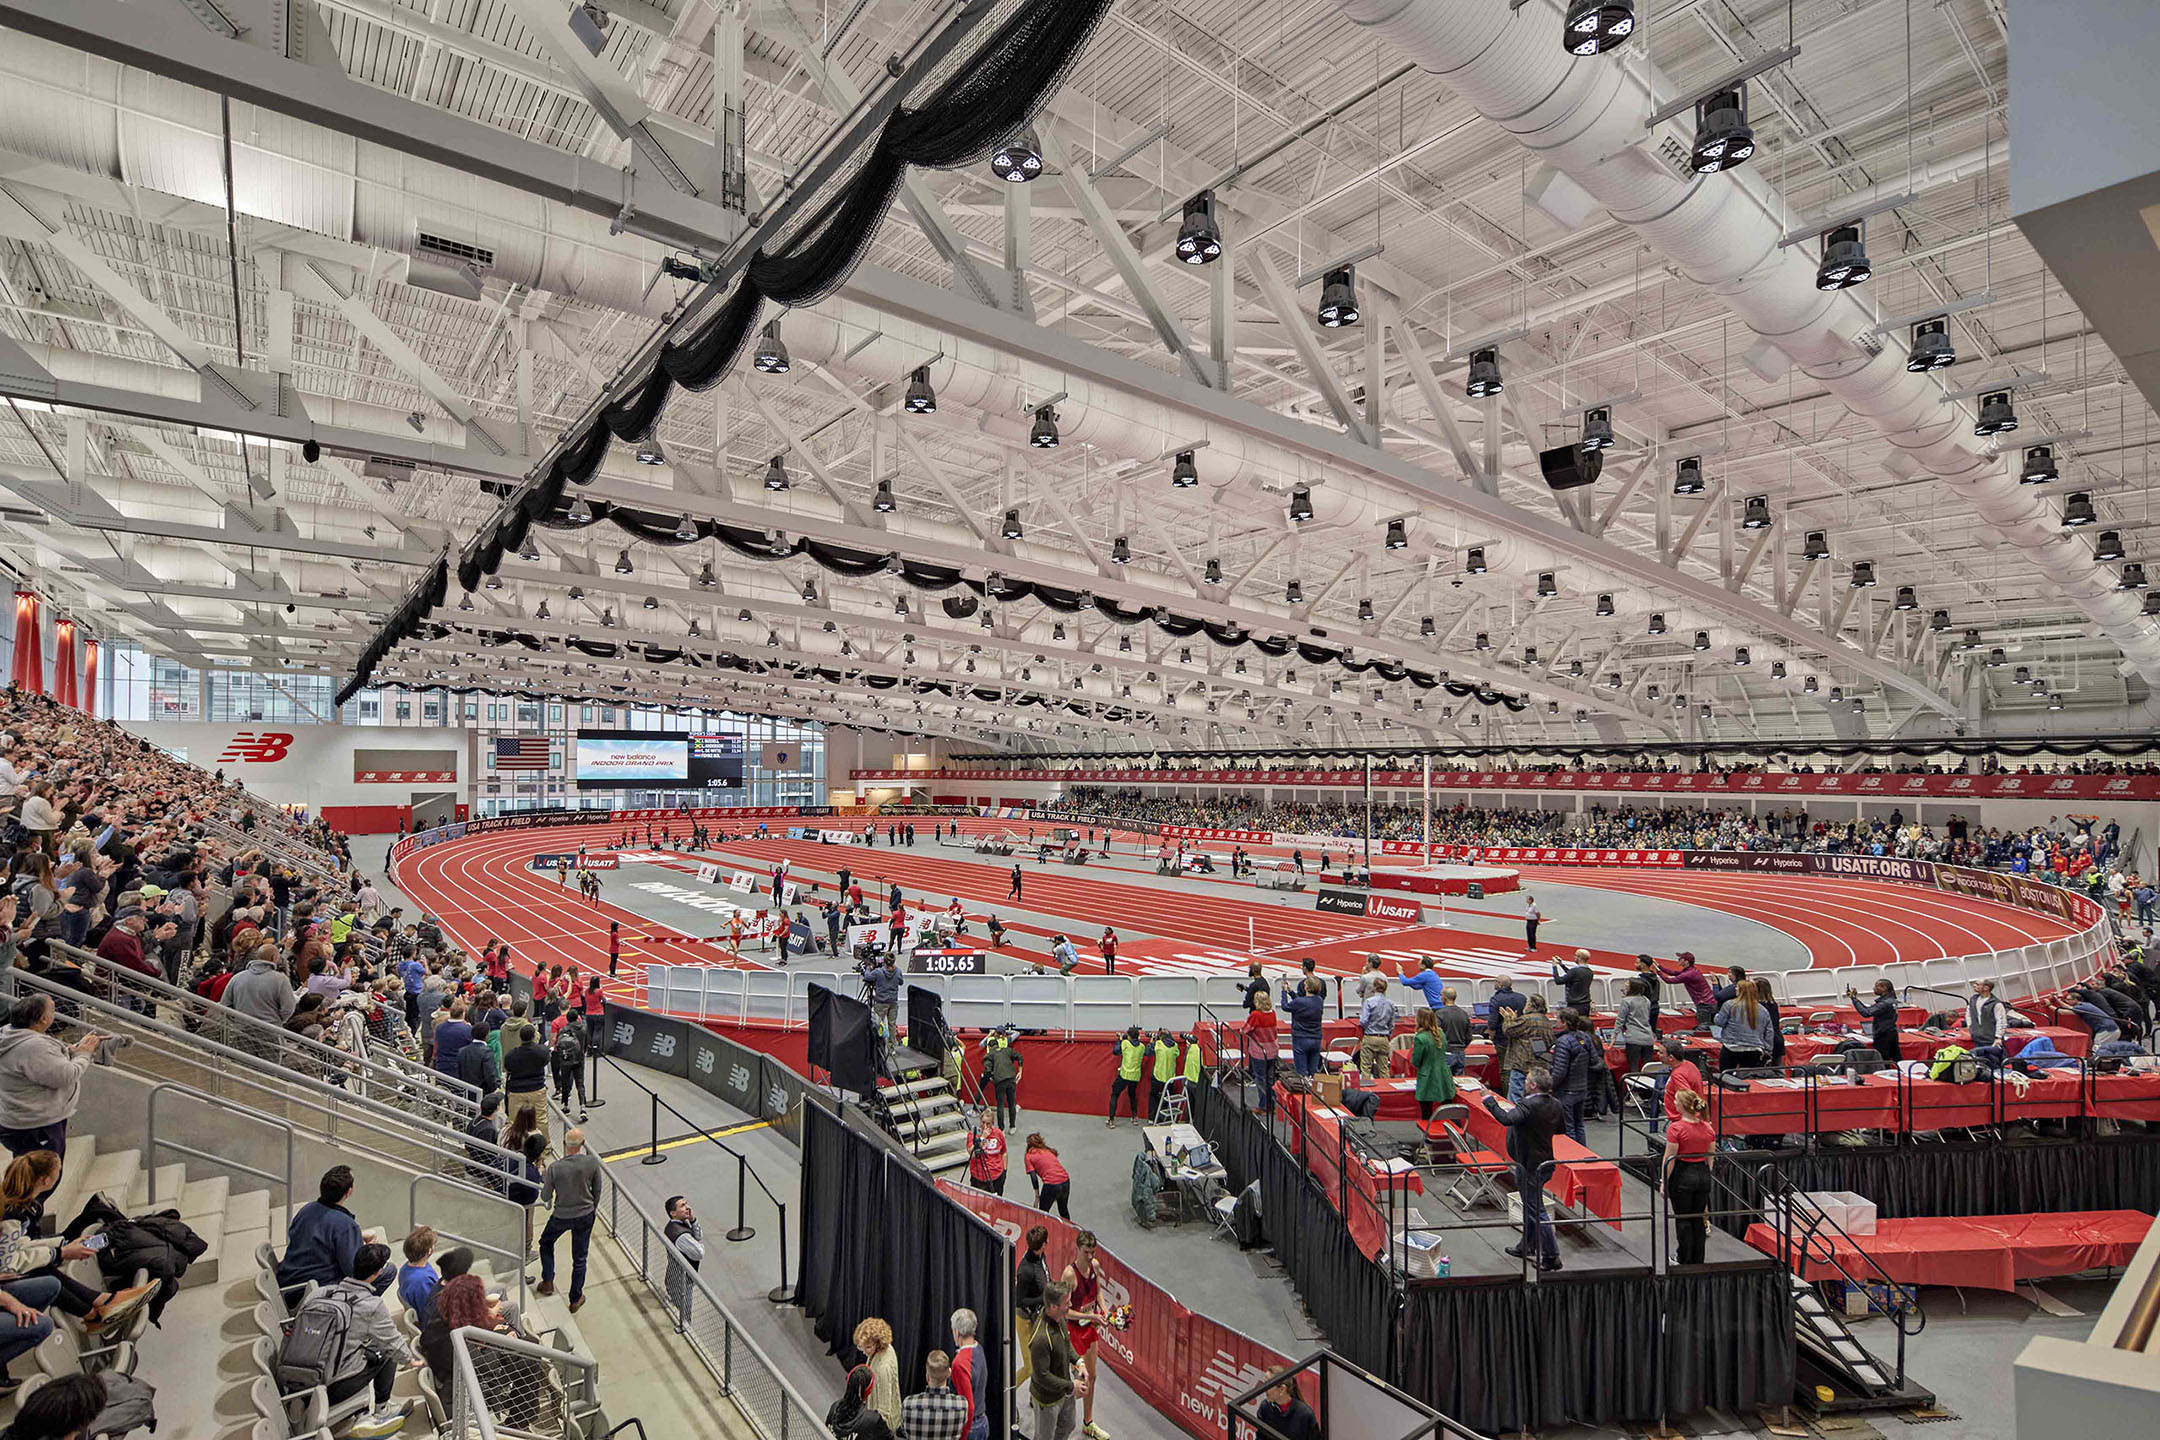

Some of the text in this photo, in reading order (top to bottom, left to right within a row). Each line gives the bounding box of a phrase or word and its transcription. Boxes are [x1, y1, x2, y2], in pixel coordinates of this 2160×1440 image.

[216, 732, 294, 763] NB
[708, 779, 727, 787] 1:05.6
[481, 820, 503, 829] TRACK
[510, 817, 531, 826] FIELD
[1047, 813, 1069, 821] TRACK
[1077, 815, 1096, 824] FIELD
[1710, 856, 1739, 865] Hyperice
[1773, 858, 1803, 867] Hyperice
[1832, 856, 1912, 879] USATF.ORG
[2020, 886, 2047, 903] BOSTON
[1336, 899, 1363, 909] Hyperice
[1381, 906, 1416, 919] USATF
[926, 956, 974, 972] 1:05.65
[1180, 1391, 1214, 1421] new
